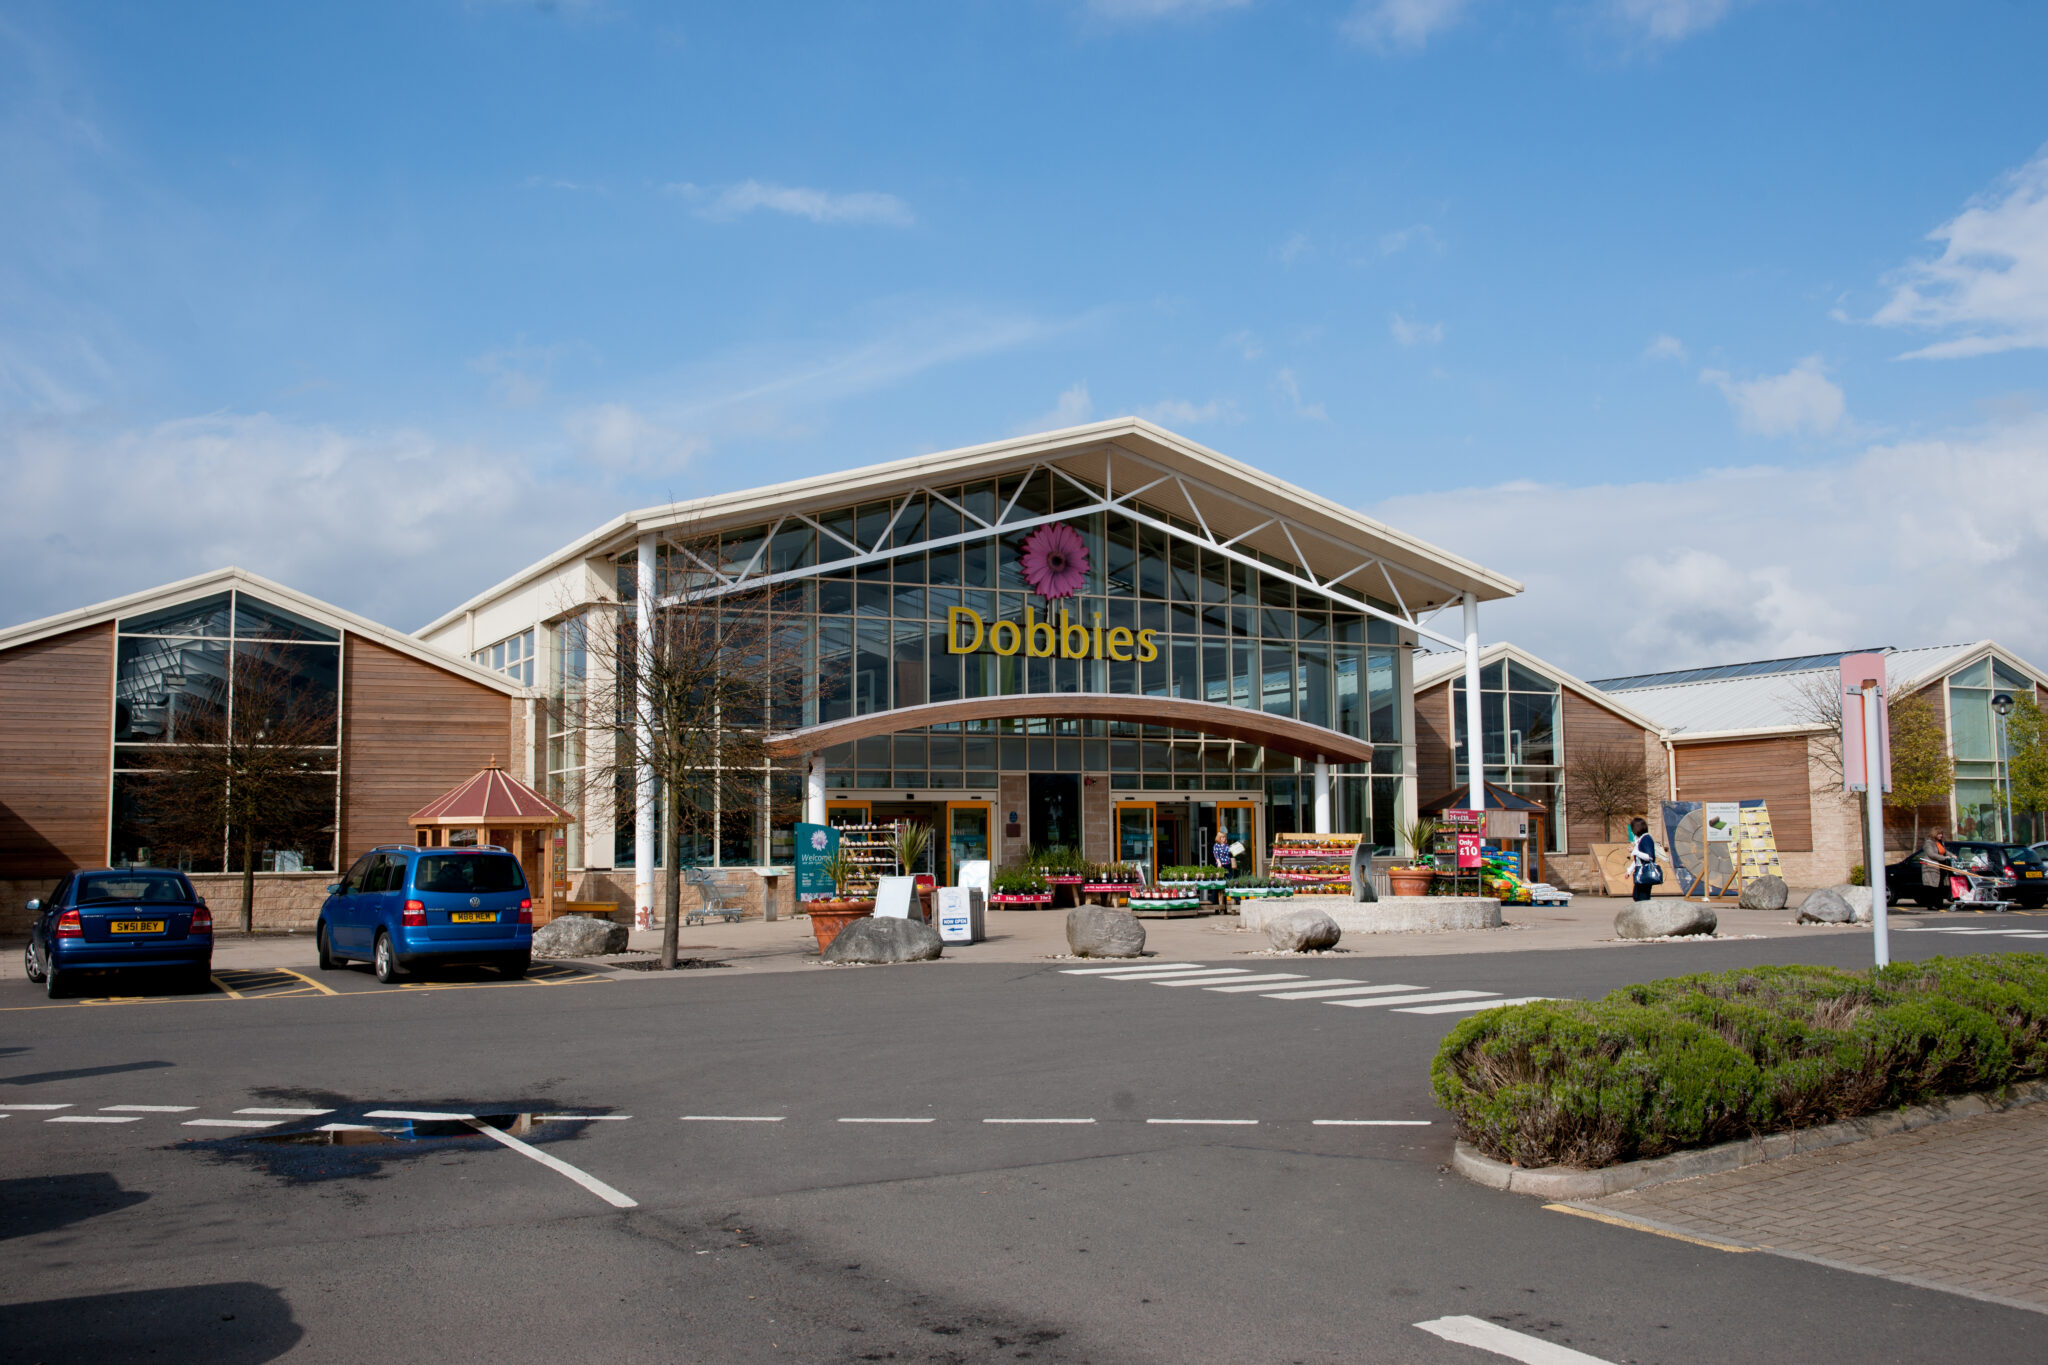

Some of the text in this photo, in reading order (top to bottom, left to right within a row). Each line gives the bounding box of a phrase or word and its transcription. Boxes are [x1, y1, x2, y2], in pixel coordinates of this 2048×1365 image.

[948, 606, 1158, 662] Dobbies
[1459, 839, 1473, 847] Only
[1460, 846, 1478, 856] £10
[117, 922, 159, 931] SW51 BEY
